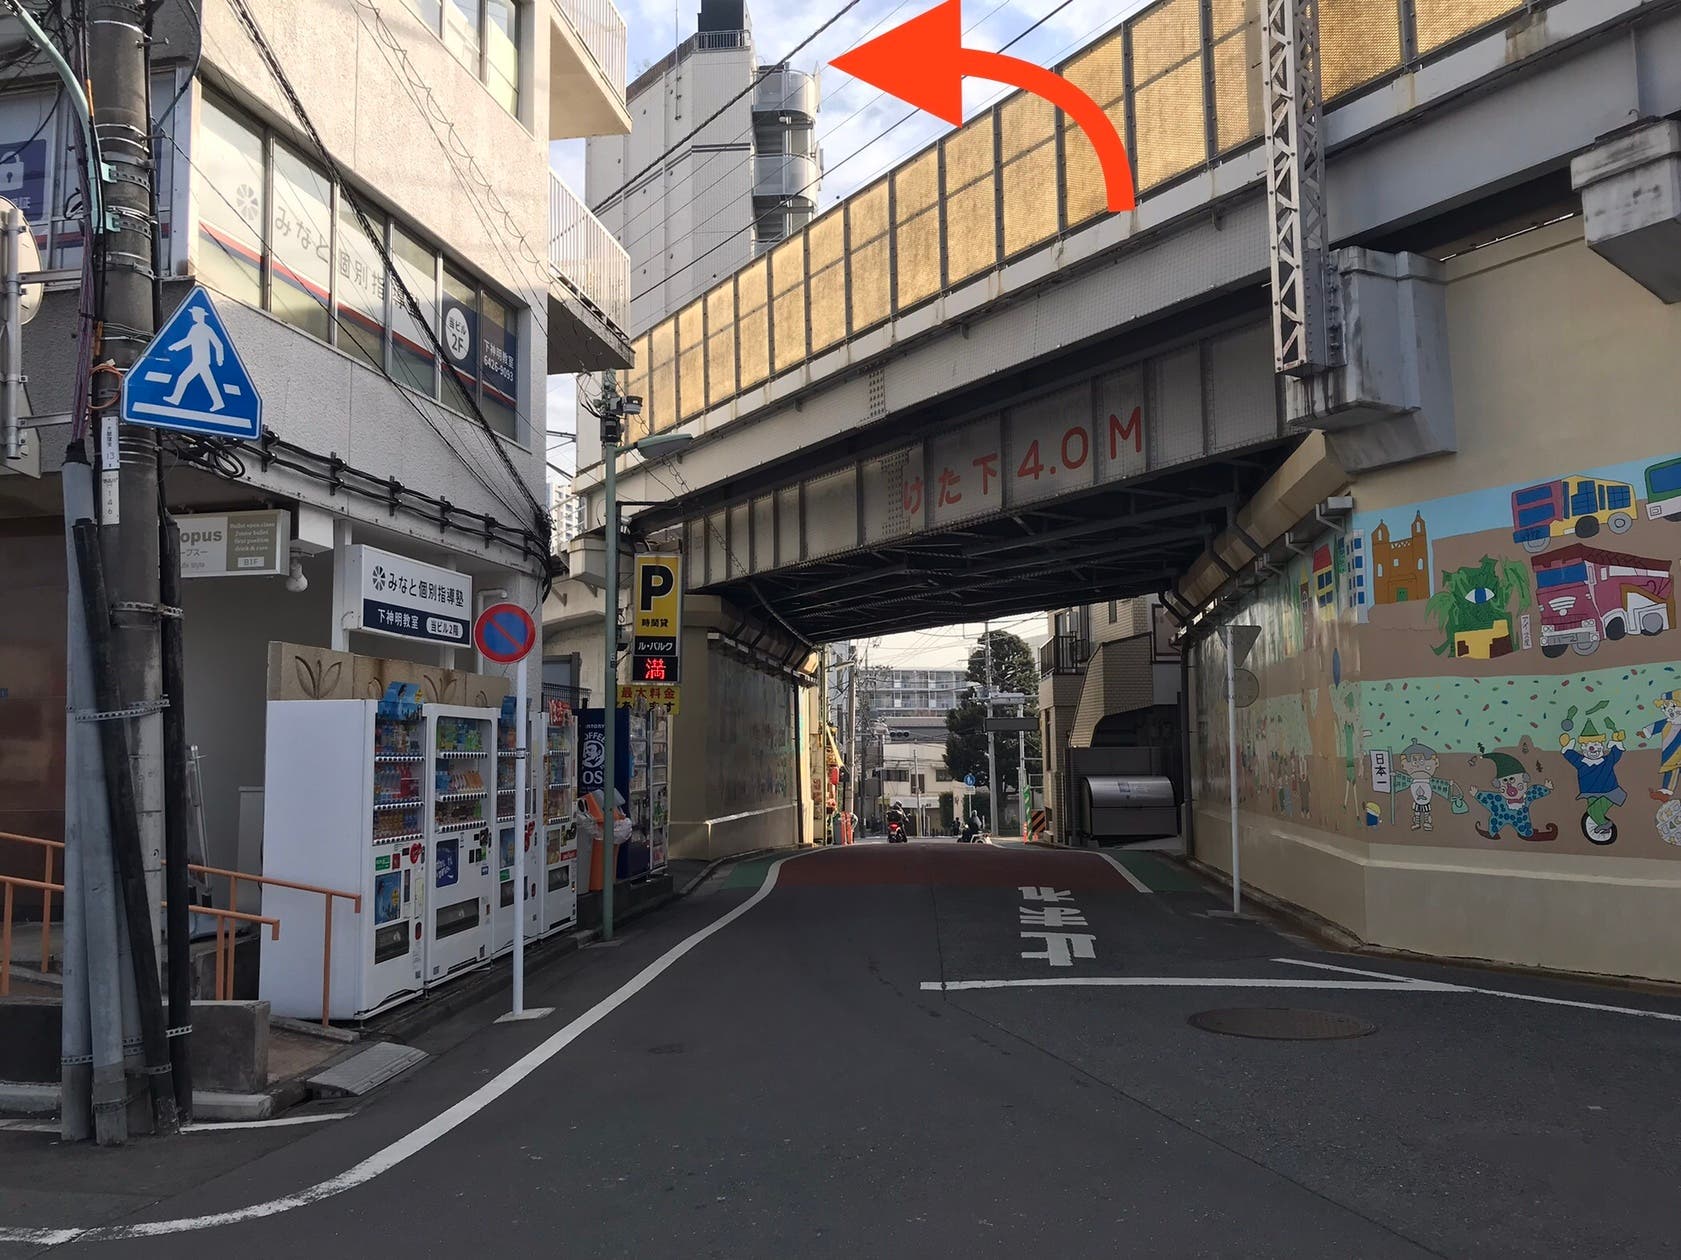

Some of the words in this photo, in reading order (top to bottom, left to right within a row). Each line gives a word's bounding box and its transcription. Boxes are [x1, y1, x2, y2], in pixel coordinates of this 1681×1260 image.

[451, 333, 464, 353] 2F
[387, 572, 464, 608] みなと個別指導塾
[641, 565, 674, 610] P
[377, 608, 419, 630] 下神明教室
[641, 618, 669, 628] 時間貸
[645, 658, 667, 680] 満
[621, 687, 676, 700] 最大料金
[1374, 753, 1387, 784] 日本一
